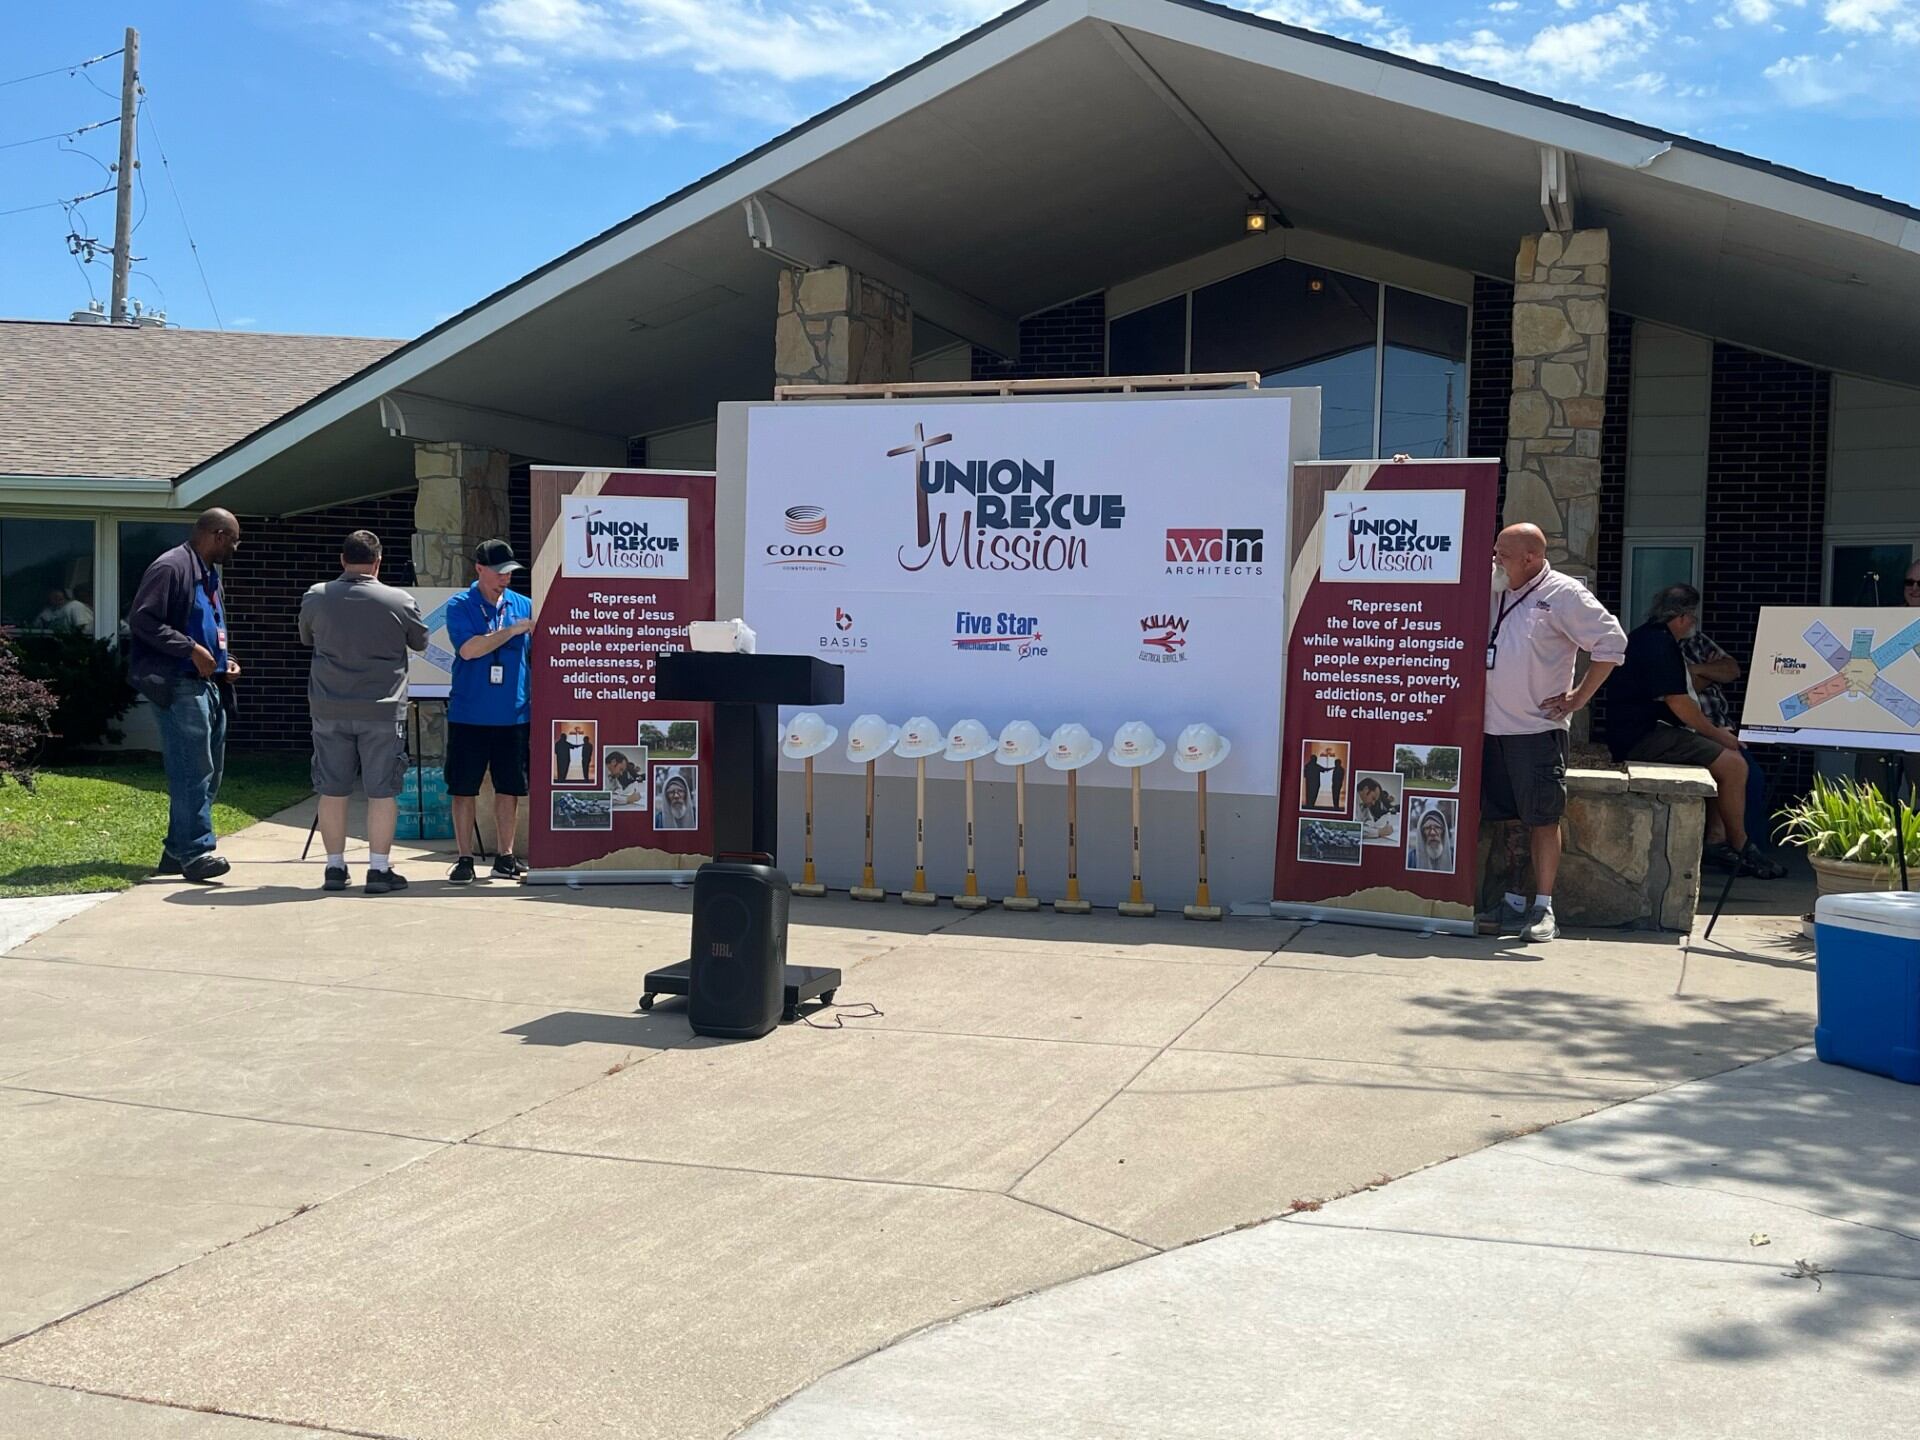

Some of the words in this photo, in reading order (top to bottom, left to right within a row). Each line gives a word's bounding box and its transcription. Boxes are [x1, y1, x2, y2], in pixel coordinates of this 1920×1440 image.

[919, 458, 1055, 497] UNION
[976, 493, 1126, 530] RESCUE
[587, 521, 648, 537] UNION
[1350, 519, 1418, 537] UNION
[613, 536, 679, 552] RESCUE
[898, 510, 1089, 572] Mission
[1378, 535, 1452, 552] RESCUE
[578, 542, 665, 569] Mission
[1338, 543, 1433, 572] Mission
[1165, 566, 1263, 576] ARCHITECTS
[570, 608, 590, 620] the
[594, 609, 619, 621] love
[623, 609, 636, 621] of
[638, 609, 675, 621] Jesus
[956, 611, 992, 635] Five
[996, 612, 1038, 636] Star
[1140, 614, 1190, 633] KILIAN
[1327, 617, 1348, 629] the
[1352, 617, 1380, 630] love
[1384, 618, 1398, 630] of
[1401, 618, 1441, 631] Jesus
[549, 625, 582, 636] while
[586, 625, 633, 639] walking
[637, 625, 690, 640] alongsid
[560, 641, 602, 654] people
[605, 641, 684, 653] experiencing
[819, 636, 869, 648] BASIS
[1303, 634, 1339, 647] while
[1343, 635, 1395, 650] walking
[1399, 636, 1464, 652] alongside
[550, 656, 643, 670] homelessness,
[1314, 653, 1360, 667] people
[1363, 655, 1450, 670] experiencing
[562, 672, 629, 686] addictions,
[632, 674, 646, 685] or
[1303, 670, 1403, 686] homelessness,
[1407, 674, 1460, 689] poverty,
[574, 688, 593, 700] life
[596, 688, 656, 703] challenge
[1315, 688, 1386, 703] addictions,
[1390, 692, 1405, 702] or
[1409, 691, 1446, 704] other
[1326, 705, 1347, 718] life
[406, 783, 437, 793] DAANI
[712, 942, 733, 958] JBL
